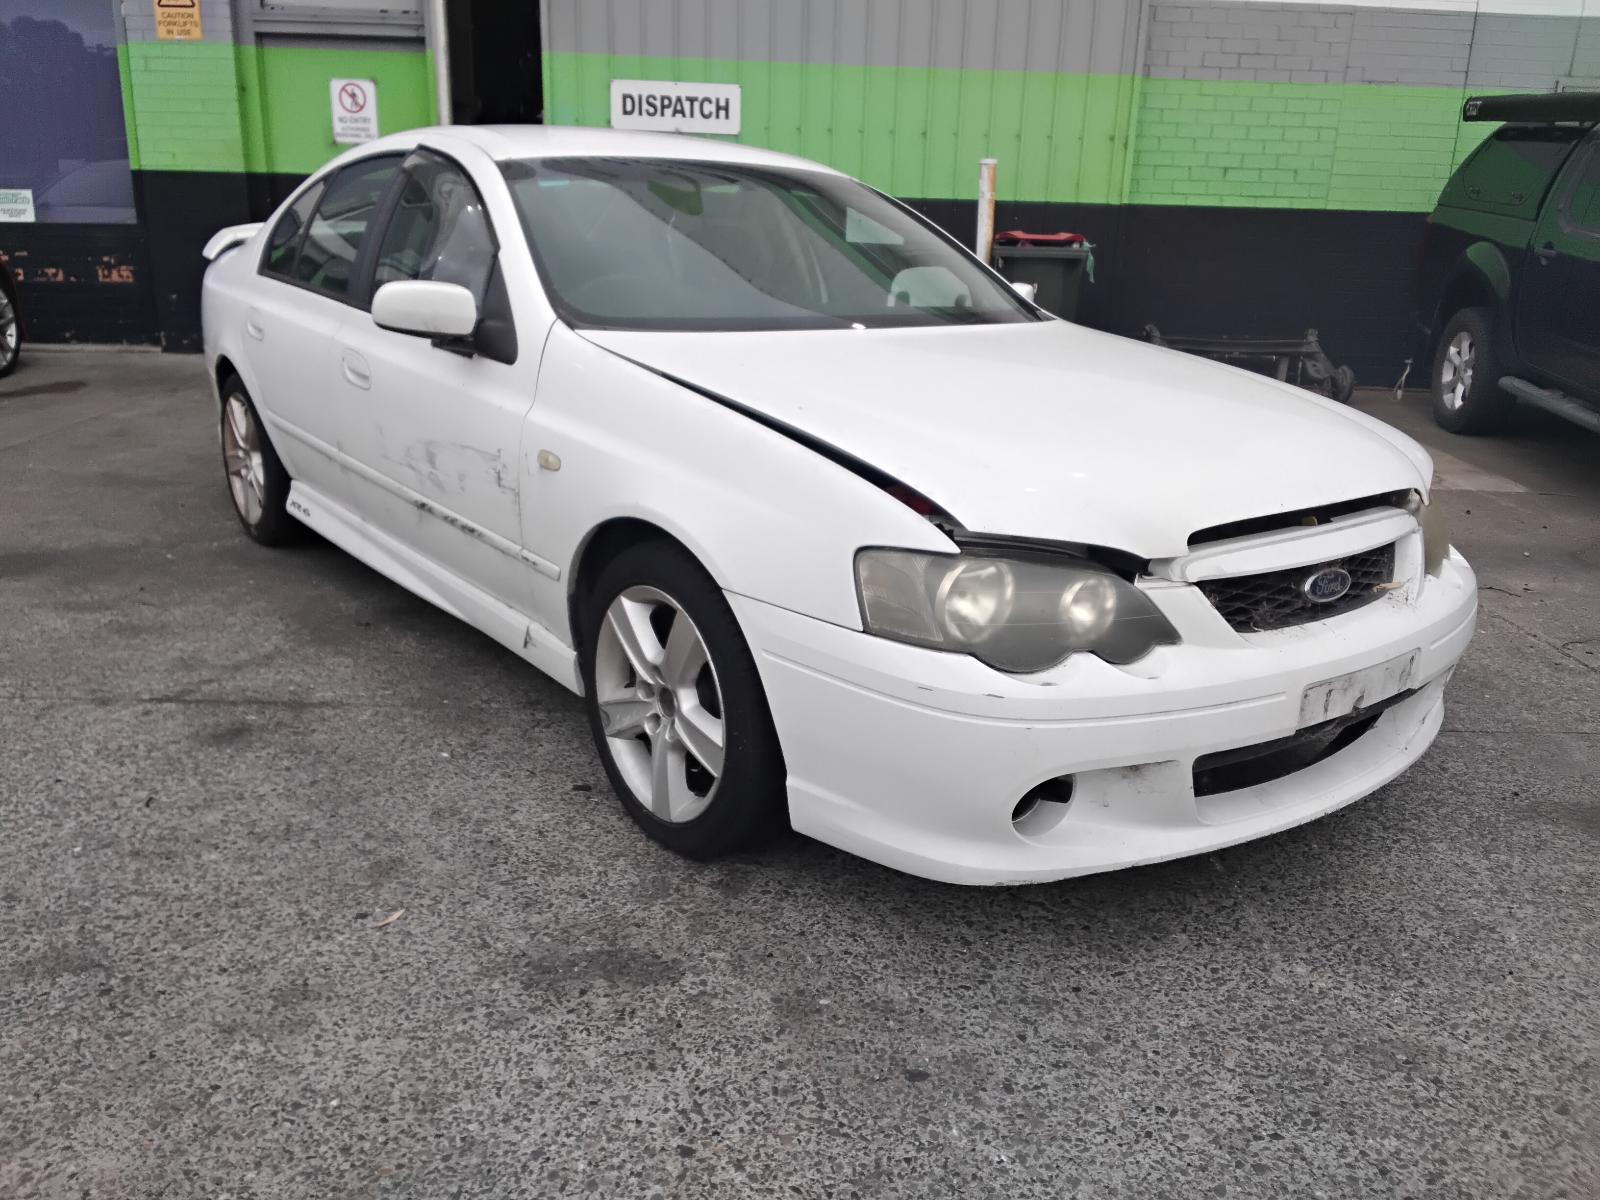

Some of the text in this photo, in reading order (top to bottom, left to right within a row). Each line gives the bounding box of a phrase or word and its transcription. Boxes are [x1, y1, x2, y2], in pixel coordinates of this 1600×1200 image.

[161, 11, 194, 19] CAUTION
[158, 20, 199, 28] FORKLIFTS
[176, 28, 192, 36] USE
[622, 93, 730, 120] DISPATCH
[337, 115, 372, 124] NO ENTRY
[1315, 574, 1344, 596] Ford
